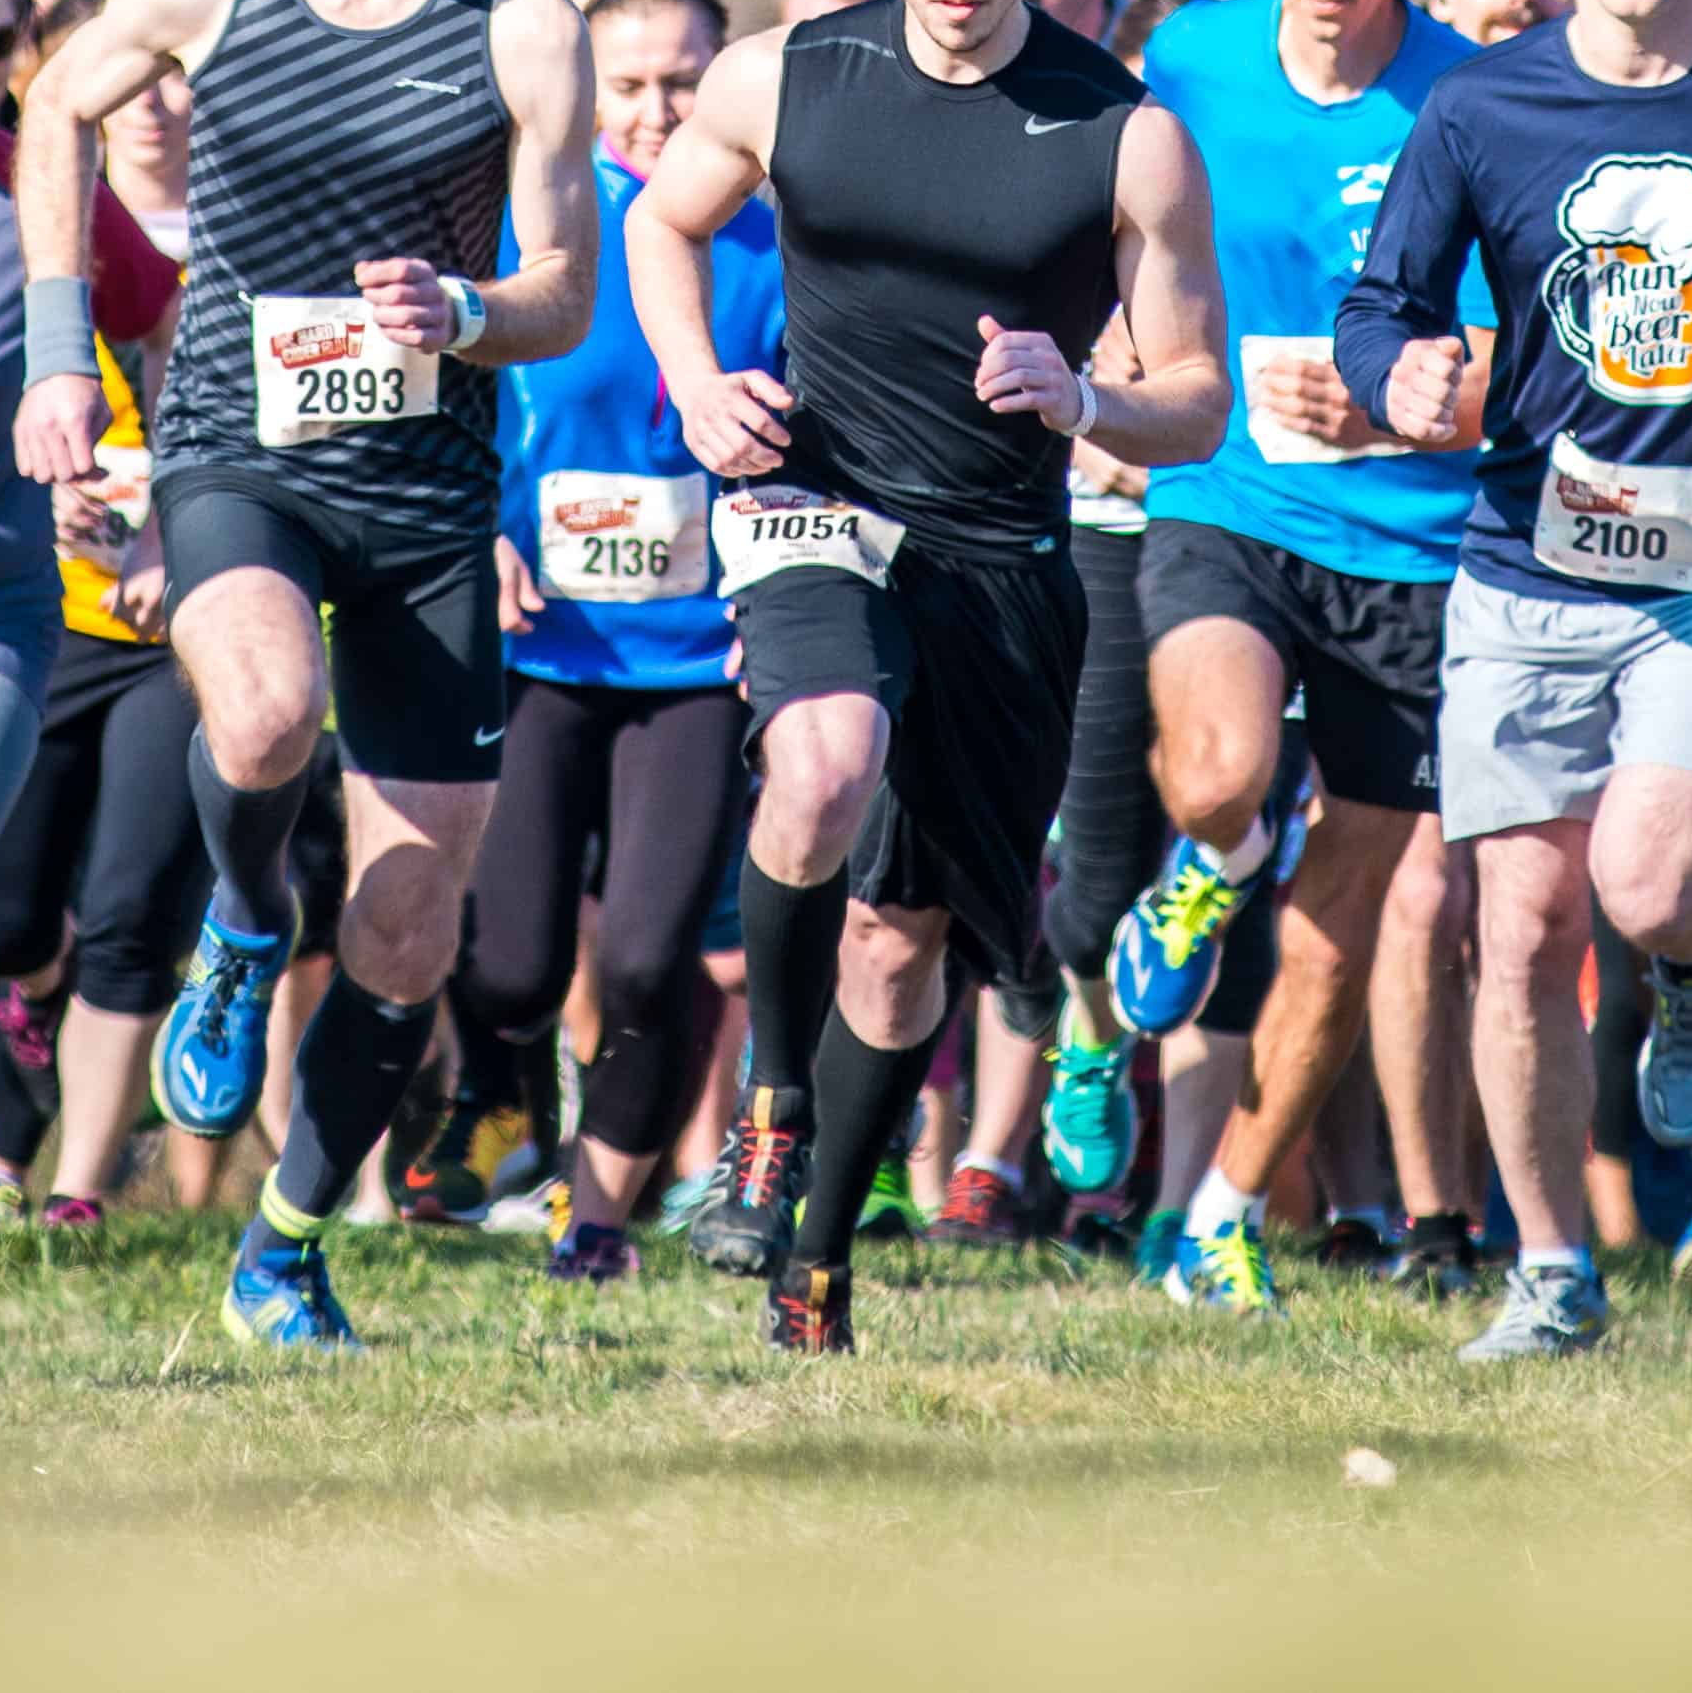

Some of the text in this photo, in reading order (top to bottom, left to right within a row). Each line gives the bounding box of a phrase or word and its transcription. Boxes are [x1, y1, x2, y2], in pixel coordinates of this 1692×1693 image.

[1597, 261, 1677, 298] Run
[1633, 293, 1682, 316] Now
[1607, 309, 1691, 349] Beer
[296, 368, 406, 415] 2893
[751, 512, 861, 543] 11054
[1571, 514, 1669, 561] 2100
[581, 535, 671, 578] 2136
